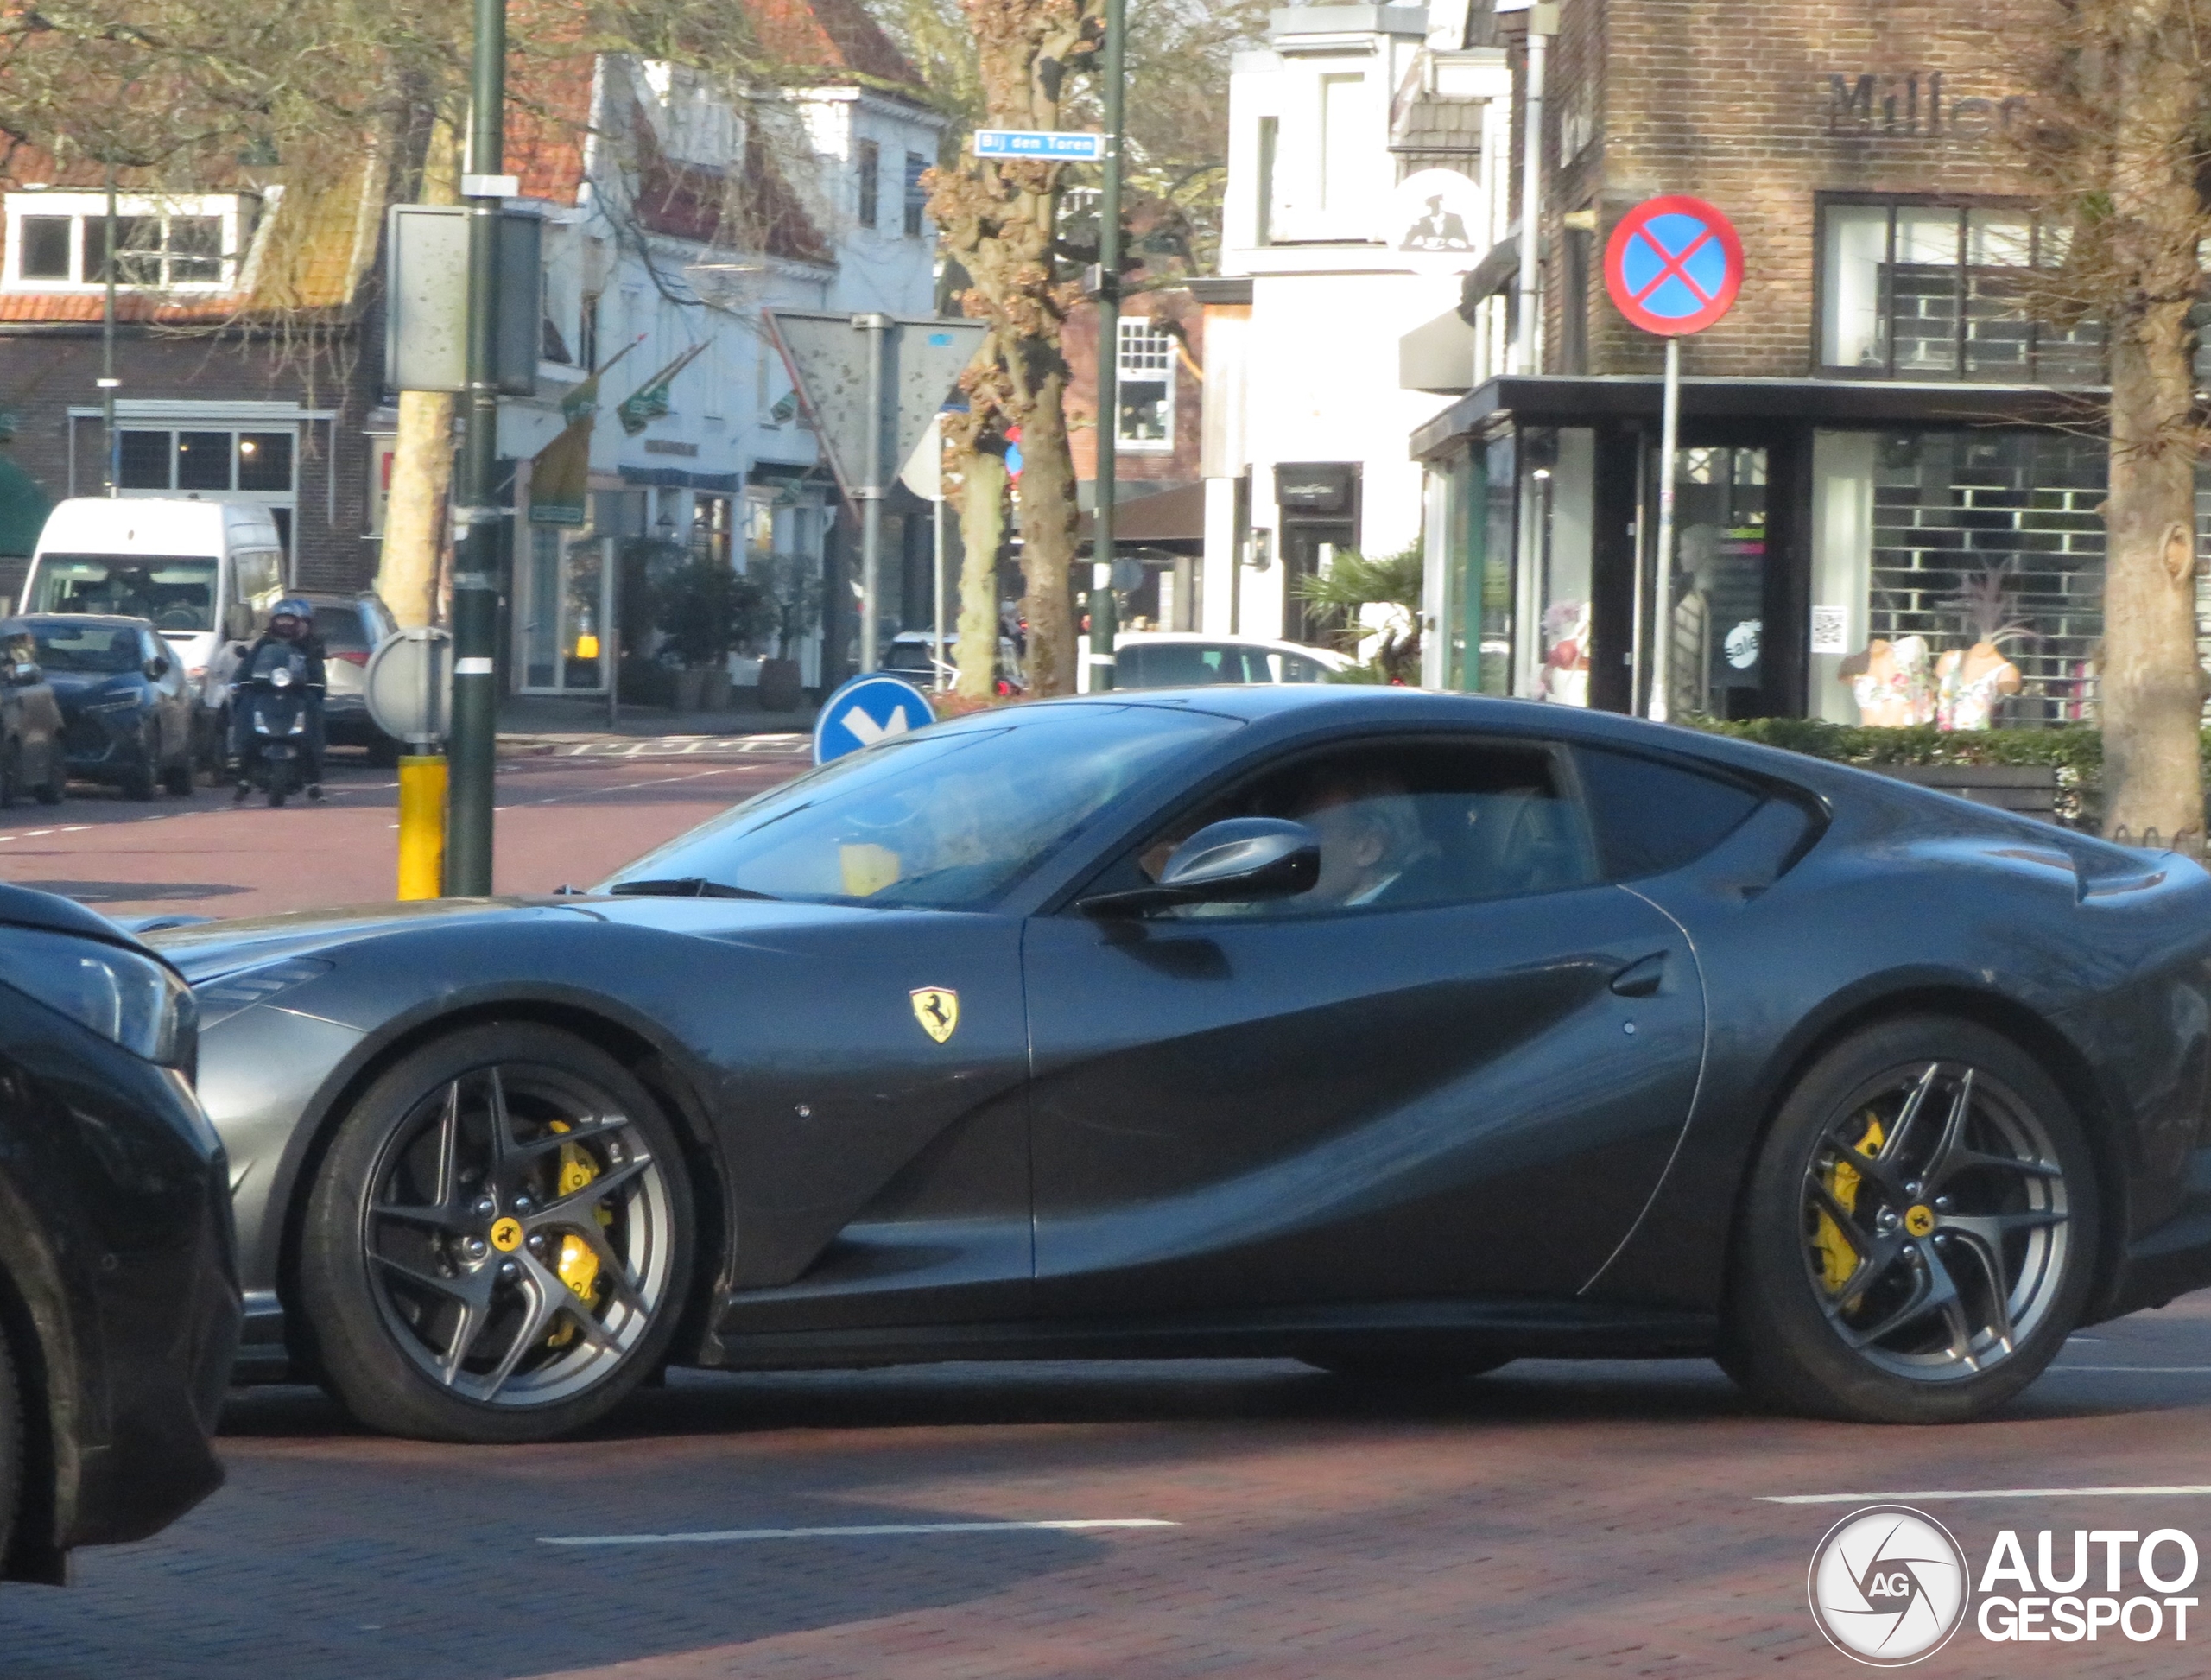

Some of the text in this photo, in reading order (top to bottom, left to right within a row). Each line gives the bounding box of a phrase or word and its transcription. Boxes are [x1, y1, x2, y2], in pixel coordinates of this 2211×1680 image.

[981, 134, 1093, 152] Bij den Toren
